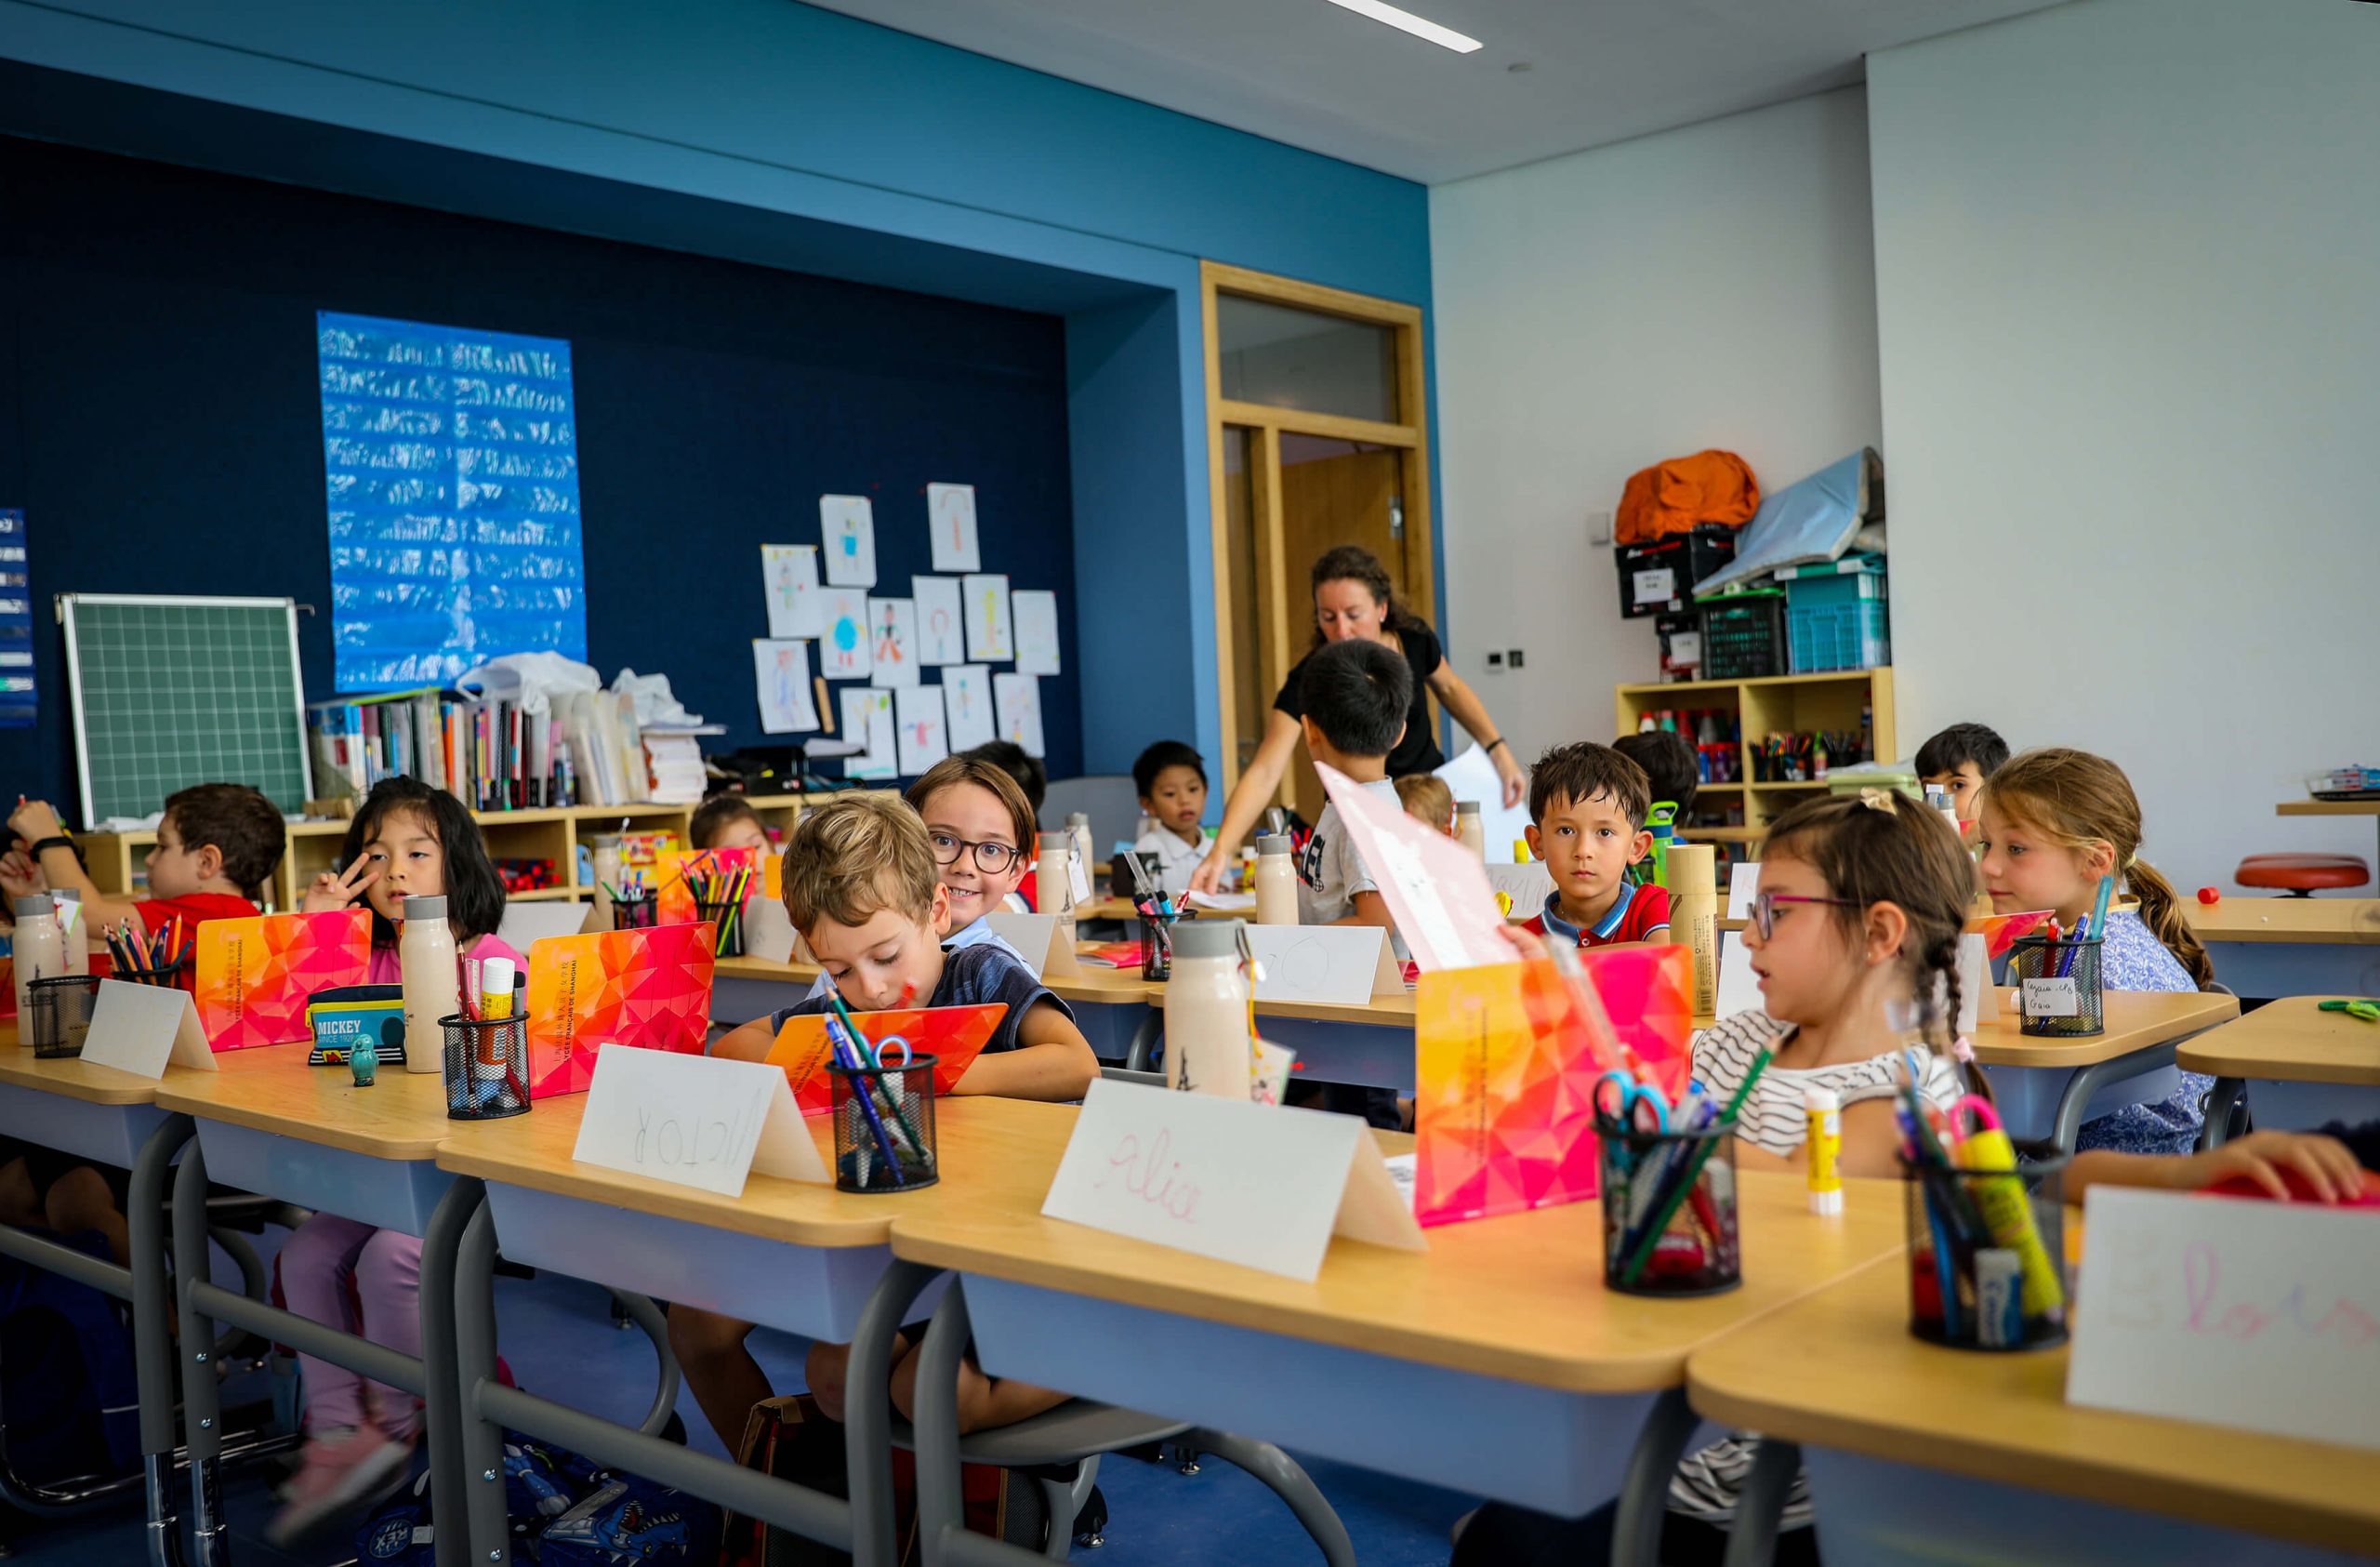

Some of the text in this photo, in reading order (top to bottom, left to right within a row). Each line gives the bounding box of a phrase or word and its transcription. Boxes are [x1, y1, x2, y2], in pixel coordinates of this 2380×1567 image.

[568, 997, 575, 1006] DE
[318, 1019, 361, 1035] MICKEY
[317, 1034, 337, 1043] SINCE
[375, 1527, 408, 1550] REX
